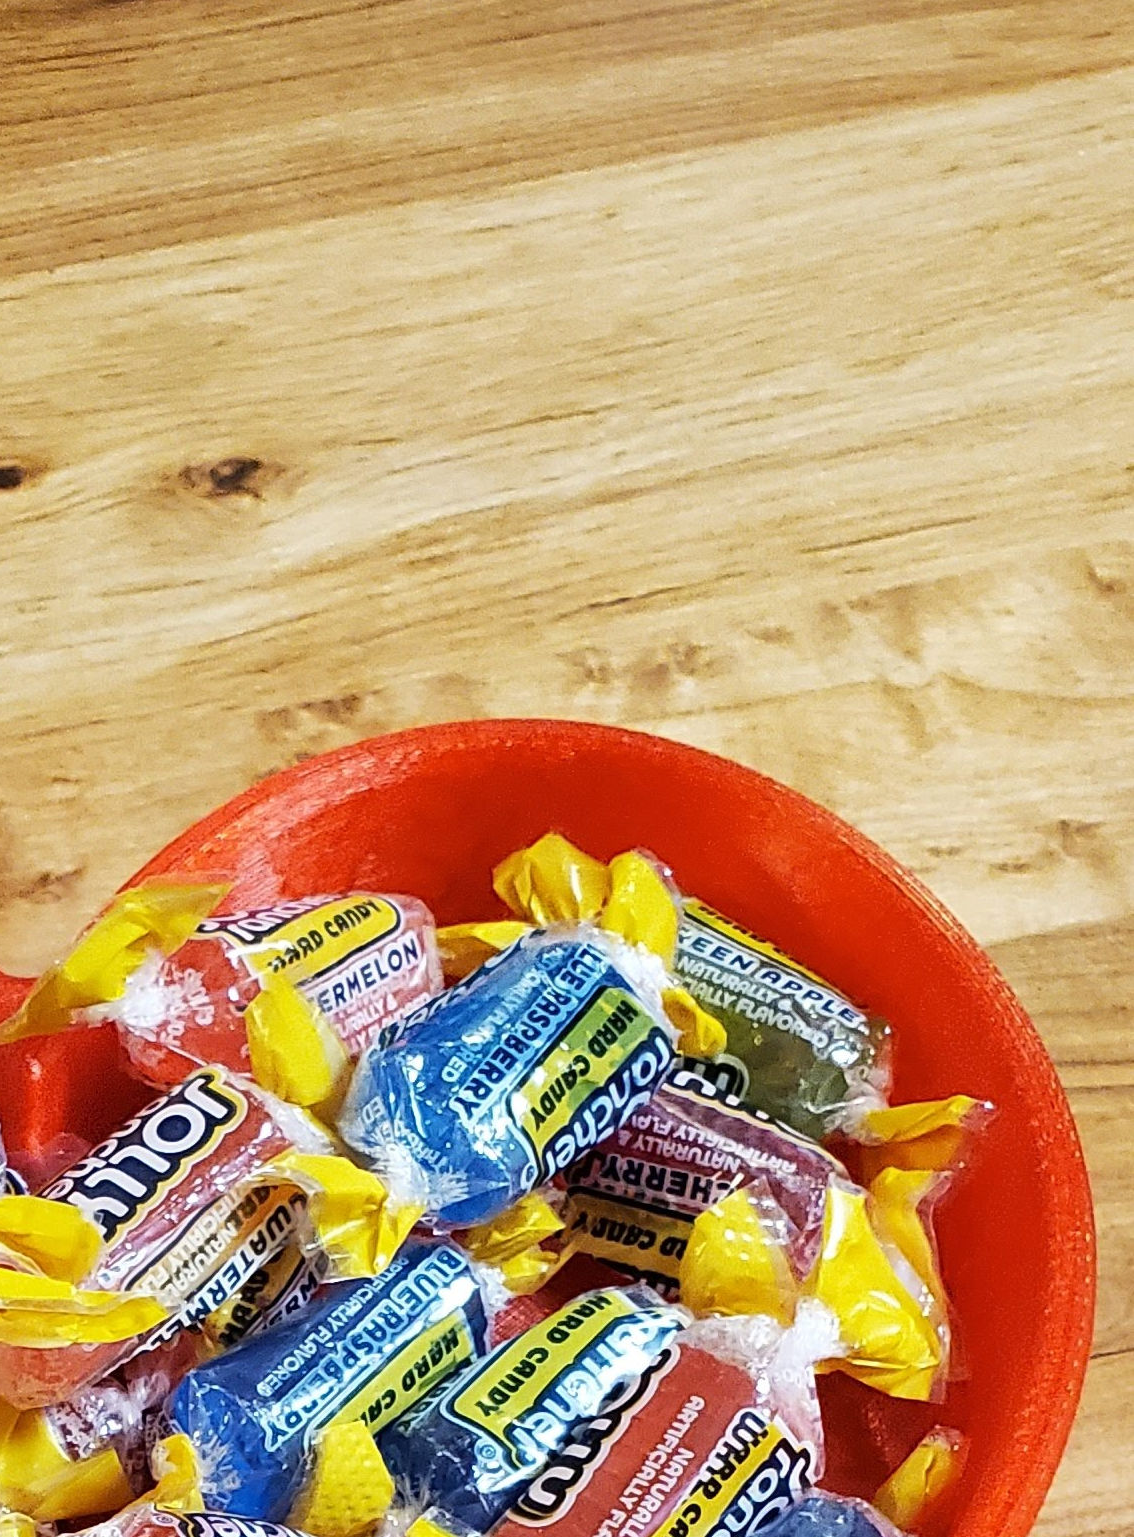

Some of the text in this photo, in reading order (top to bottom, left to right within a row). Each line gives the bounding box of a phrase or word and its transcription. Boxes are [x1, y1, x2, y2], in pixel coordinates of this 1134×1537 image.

[322, 893, 382, 940] CANDY
[312, 936, 424, 1014] ERMELON
[678, 957, 776, 1004] NATURALLY
[758, 969, 866, 1028] APPLE
[454, 944, 604, 1119] LUE RASPBERRY
[532, 1000, 638, 1131] HARD CANDY
[542, 1036, 674, 1178] rancher
[68, 1078, 228, 1241] JOLLY
[600, 1156, 741, 1205] CHERRY
[635, 1136, 742, 1173] NATURALLY
[396, 1247, 463, 1312] BLUE
[545, 1292, 610, 1348] HARD
[254, 1324, 332, 1398] FLAVORED
[397, 1327, 460, 1393] HARD
[474, 1342, 550, 1417] CANDY
[617, 1393, 706, 1510] ARTIFICIALLY
